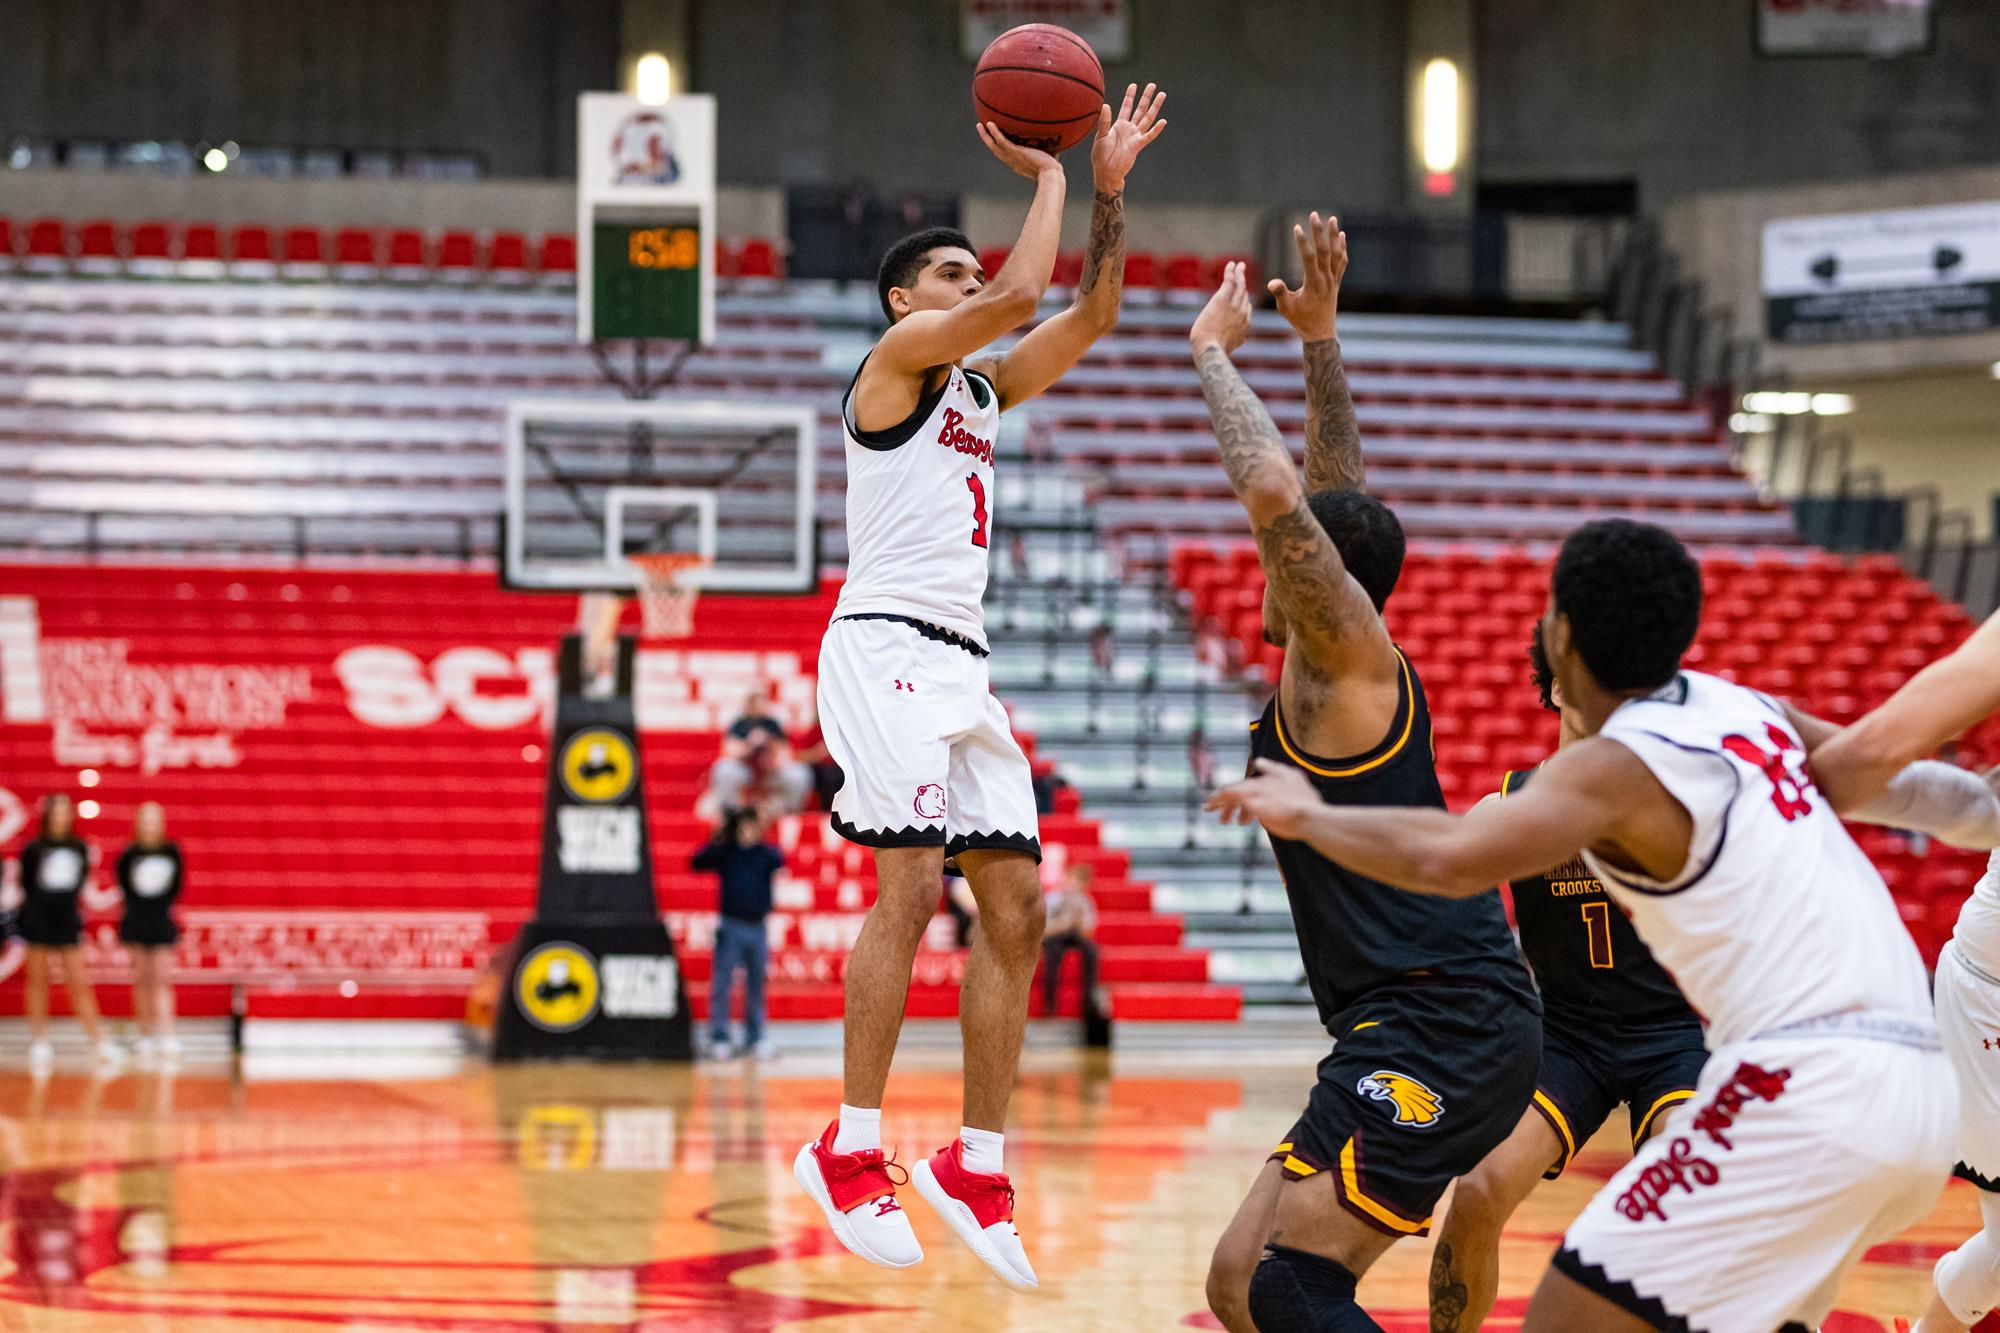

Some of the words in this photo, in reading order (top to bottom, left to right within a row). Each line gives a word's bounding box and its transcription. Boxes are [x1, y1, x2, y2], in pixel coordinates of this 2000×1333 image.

[966, 472, 988, 549] 1
[1551, 880, 1602, 896] CROOKS
[1581, 902, 1613, 968] 1
[1616, 1137, 1719, 1222] State
